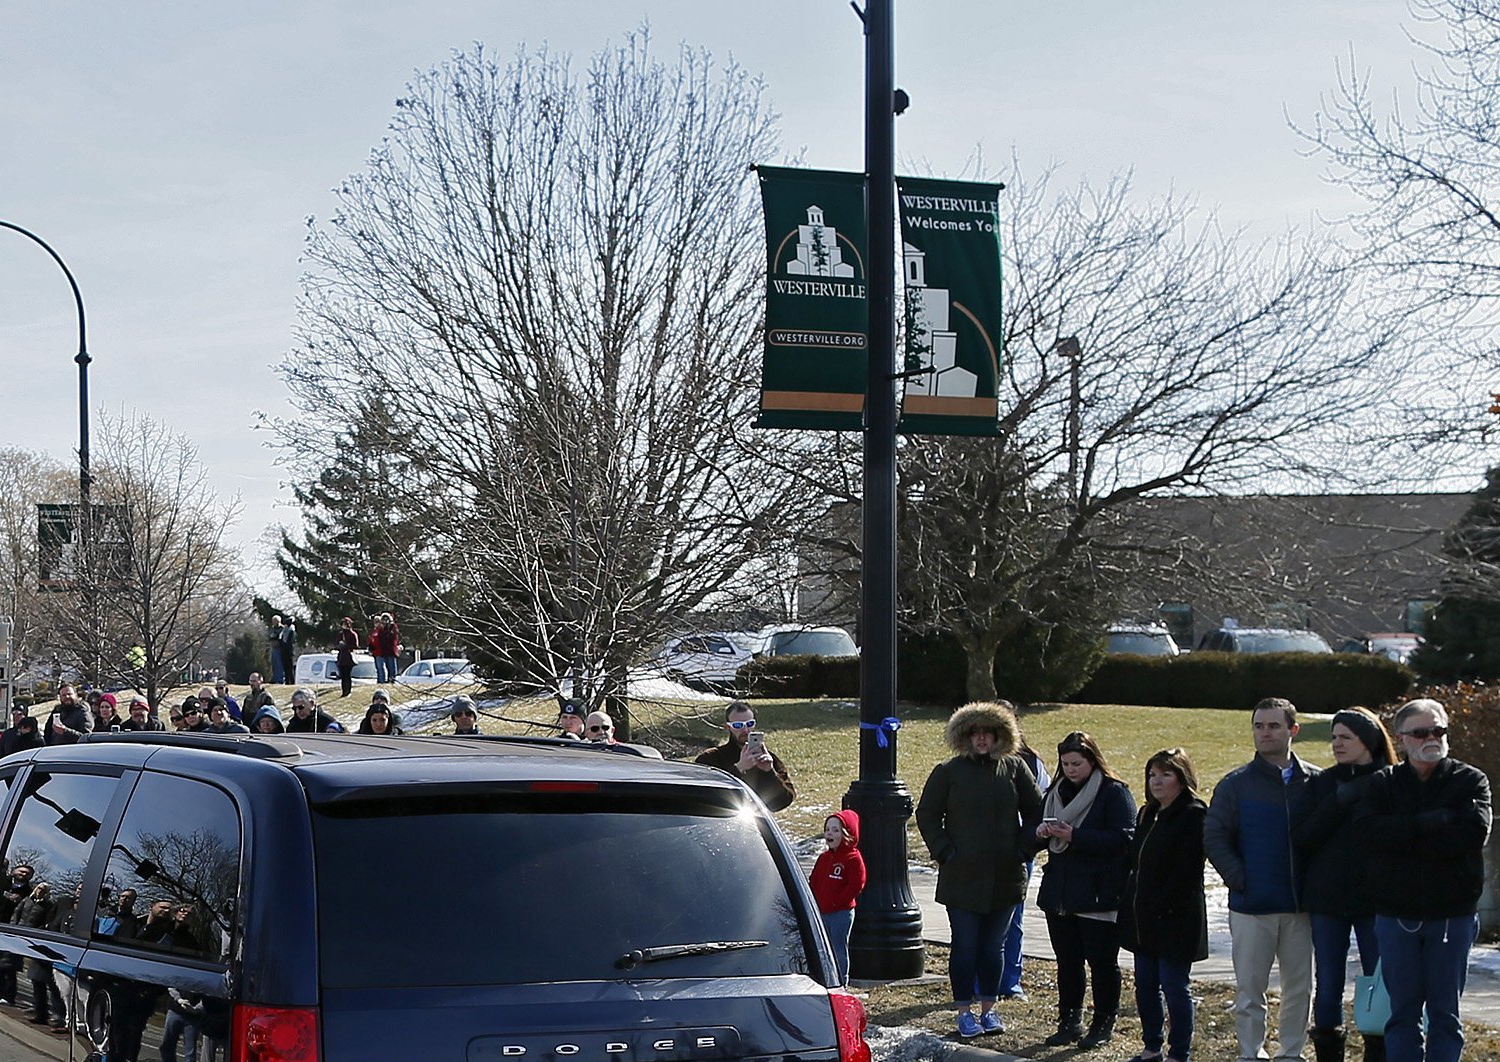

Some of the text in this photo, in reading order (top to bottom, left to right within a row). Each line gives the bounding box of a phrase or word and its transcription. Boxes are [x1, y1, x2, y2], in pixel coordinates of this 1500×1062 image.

[902, 195, 998, 213] WESTERVILLE
[906, 216, 972, 231] Welcomes
[773, 280, 866, 299] WESTERVILLE
[776, 333, 864, 346] WESTERVILLE.ORG
[502, 1036, 717, 1056] DODGE
